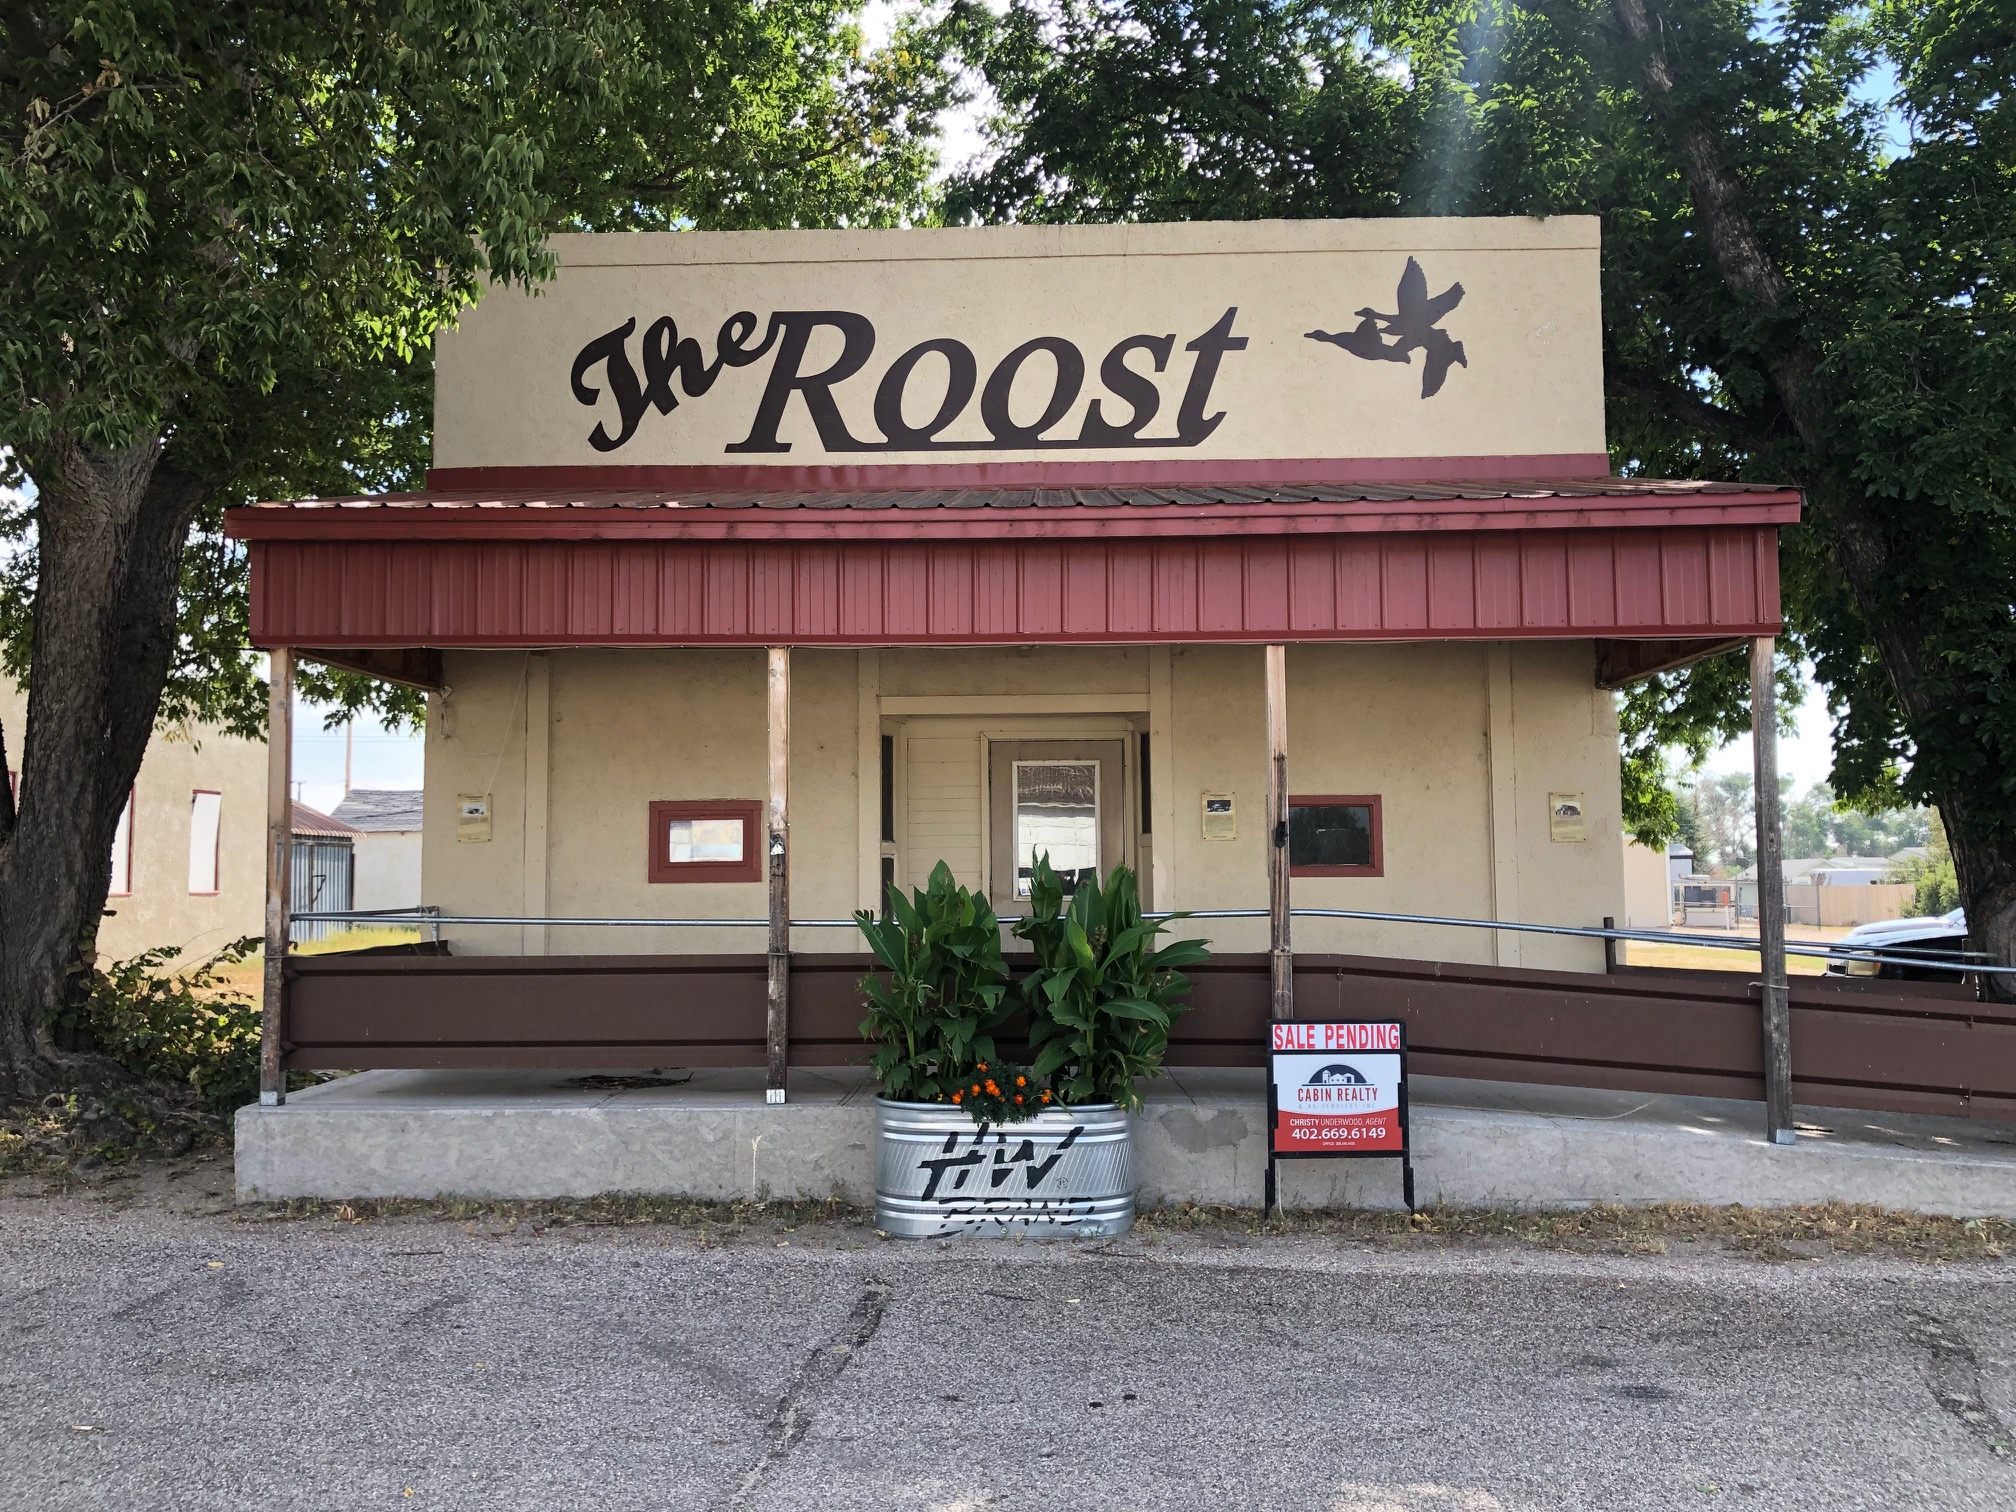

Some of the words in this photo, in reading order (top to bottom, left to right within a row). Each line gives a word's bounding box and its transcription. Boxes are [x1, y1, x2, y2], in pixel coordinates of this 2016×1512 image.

[571, 311, 777, 453] The
[724, 306, 1250, 453] Roost
[1274, 1024, 1316, 1050] SALE
[1325, 1024, 1400, 1049] PENDING
[1297, 1088, 1332, 1102] CABIN
[1337, 1087, 1378, 1102] REALTY
[1290, 1118, 1320, 1127] CHRISTY
[1320, 1118, 1364, 1127] UNDERWOOD,
[1365, 1117, 1387, 1126] AGENT
[1291, 1127, 1386, 1140] 402.669.6149
